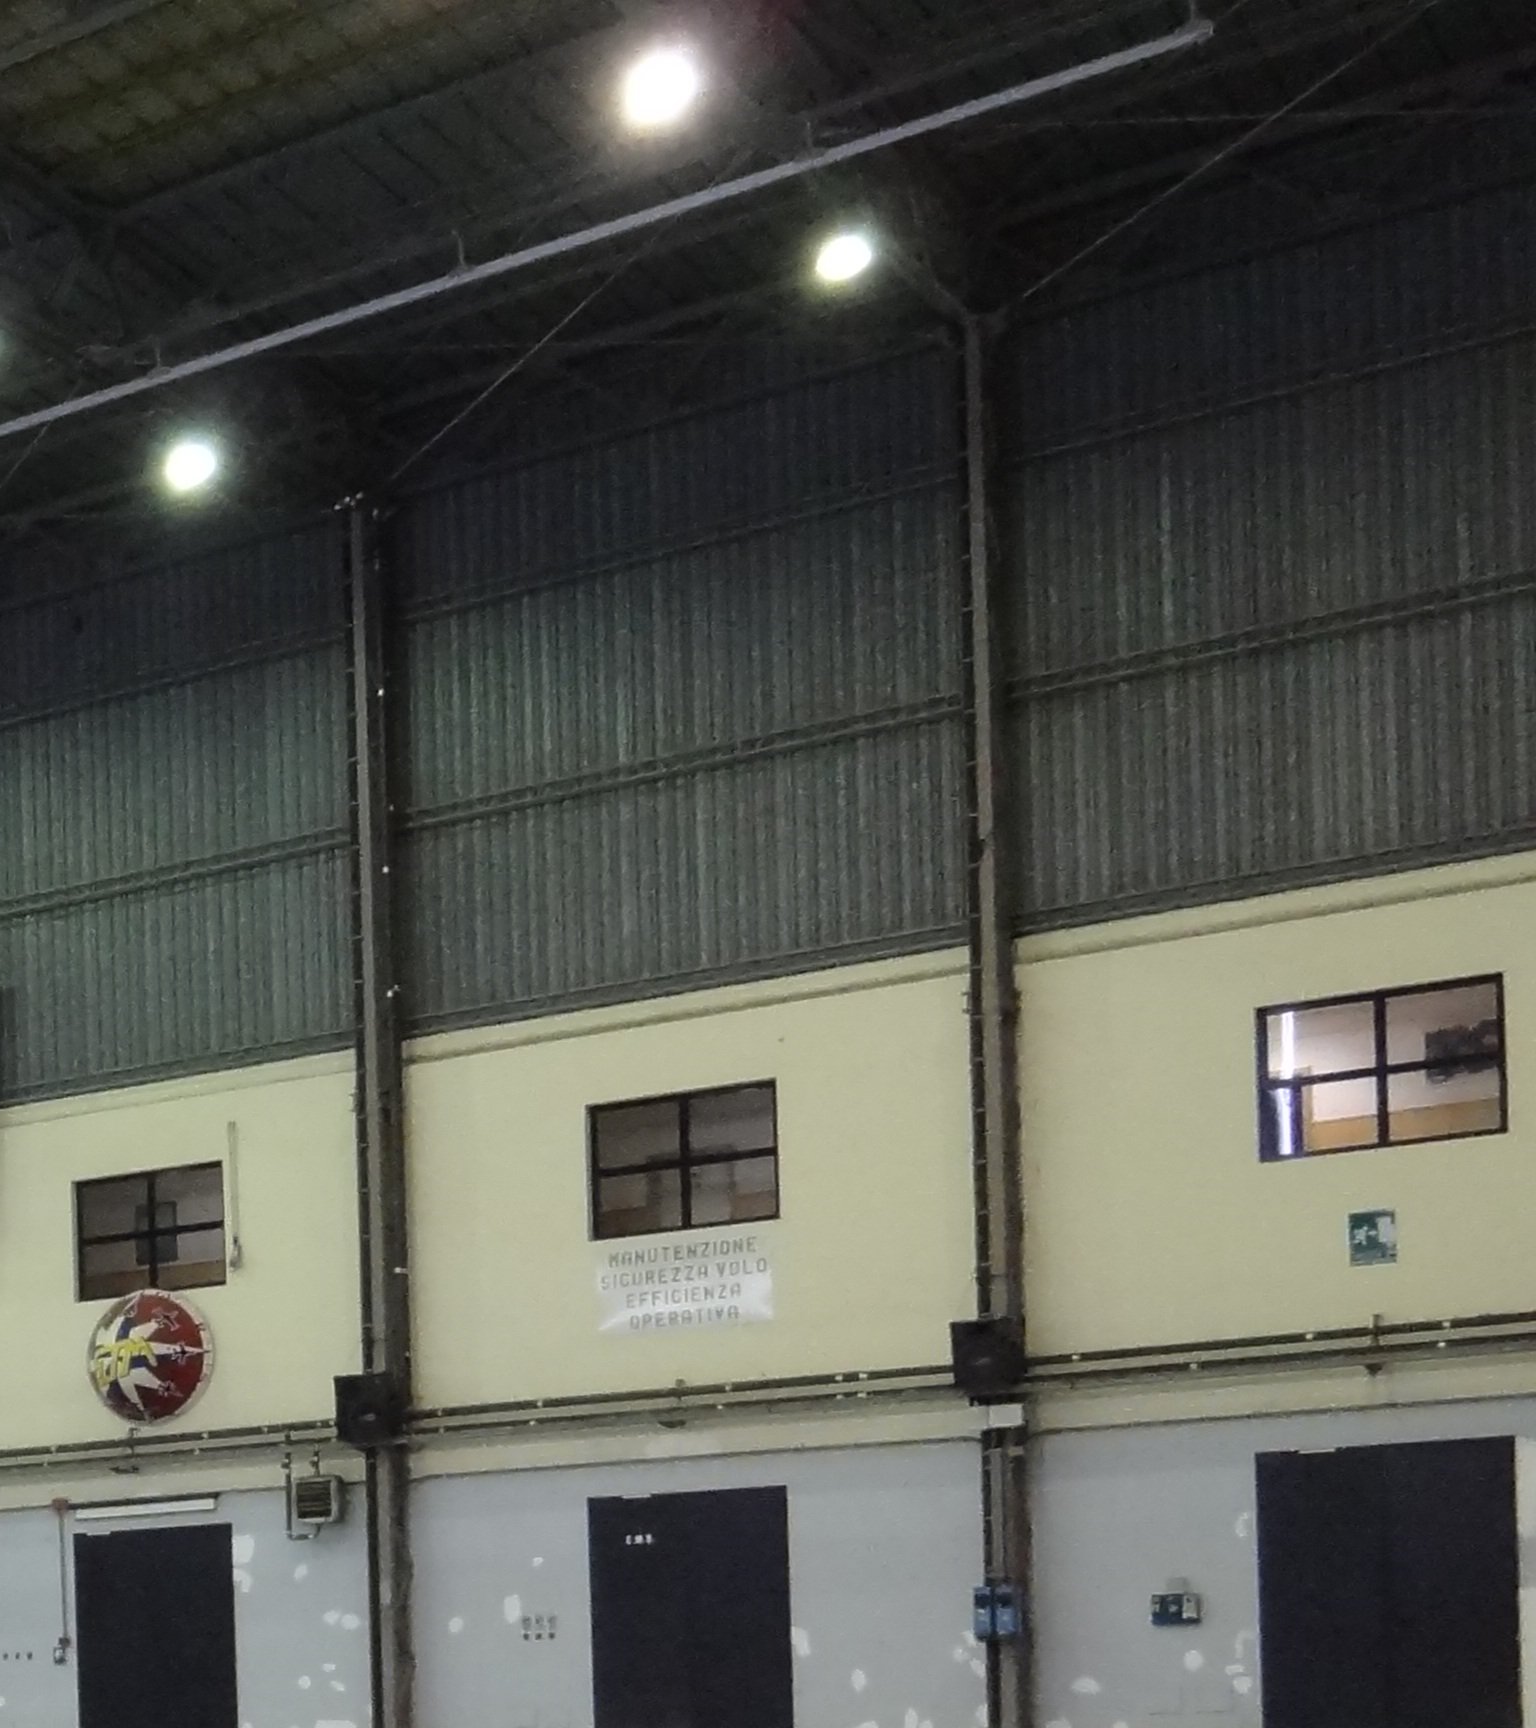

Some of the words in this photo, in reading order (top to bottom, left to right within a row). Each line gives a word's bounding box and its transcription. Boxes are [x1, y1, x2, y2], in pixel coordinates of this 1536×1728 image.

[608, 1237, 757, 1268] MANUTENZIONE
[600, 1265, 709, 1291] SICUREZZA
[716, 1257, 768, 1279] VOLO
[626, 1283, 742, 1309] EFFICIENZA
[630, 1305, 740, 1330] OPERATIVA
